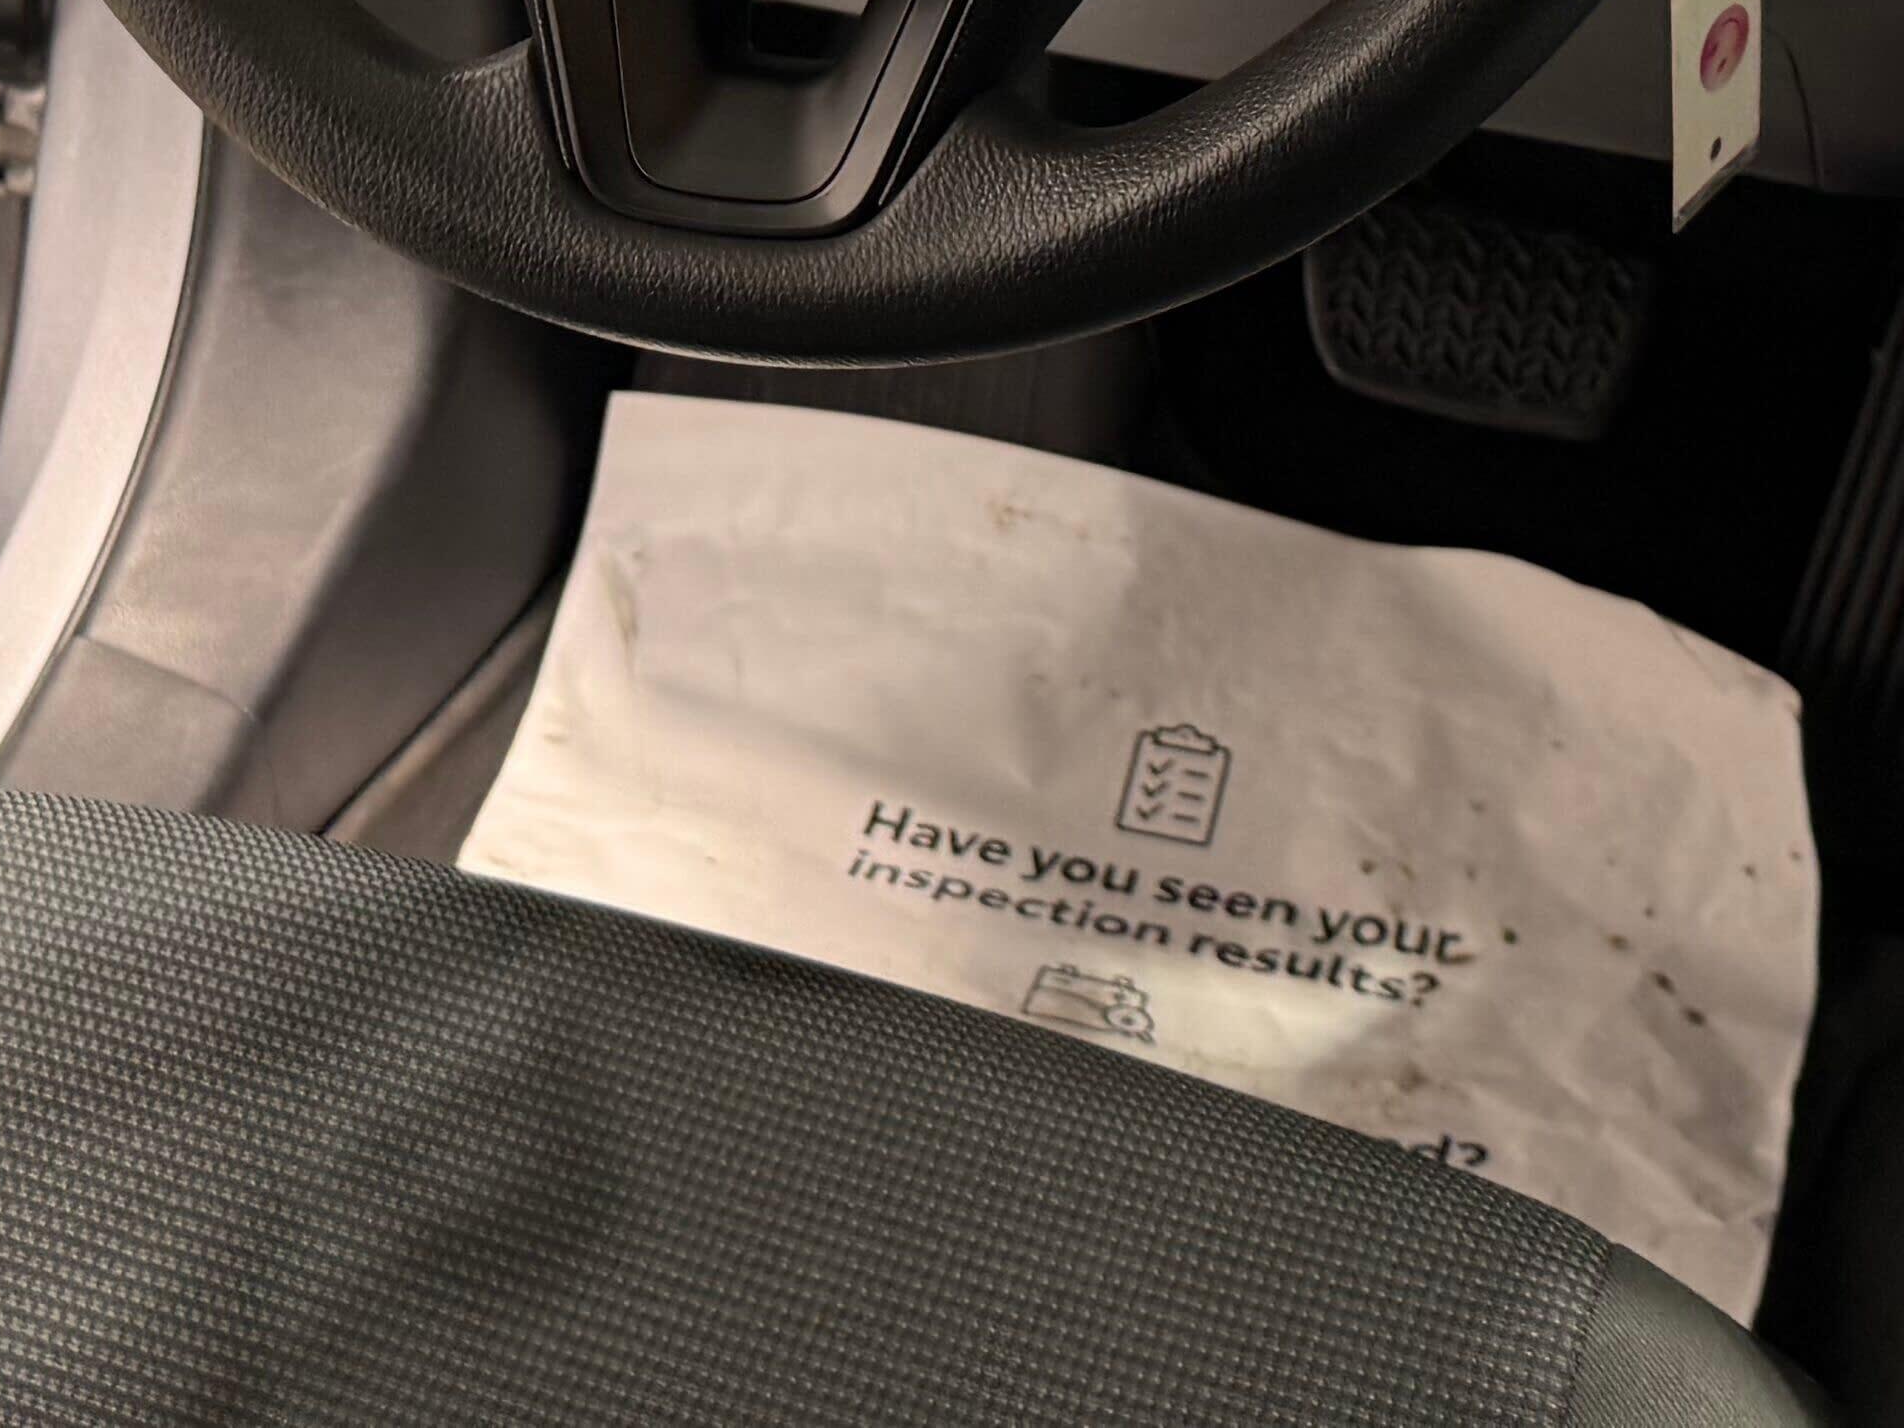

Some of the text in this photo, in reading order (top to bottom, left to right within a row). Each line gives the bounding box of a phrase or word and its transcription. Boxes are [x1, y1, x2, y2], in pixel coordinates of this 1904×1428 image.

[847, 848, 1441, 1008] inspection results?
[863, 800, 1464, 964] Have you seen your
